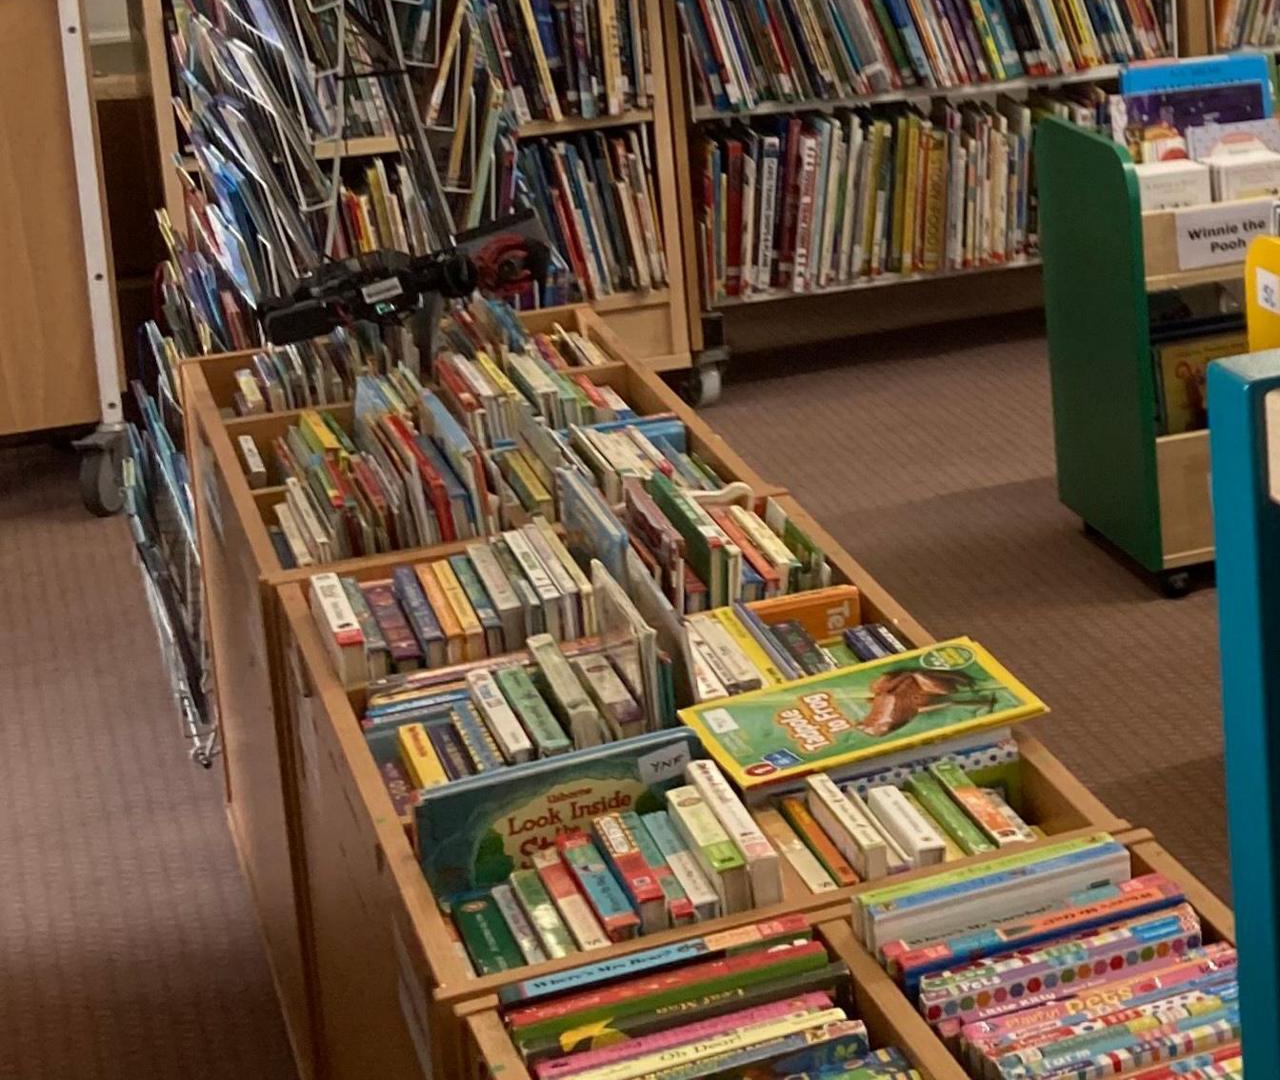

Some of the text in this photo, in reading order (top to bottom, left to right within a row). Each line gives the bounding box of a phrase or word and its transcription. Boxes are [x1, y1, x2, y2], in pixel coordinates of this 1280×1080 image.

[1188, 218, 1266, 242] Winnie the
[1210, 238, 1247, 254] Pooh
[777, 708, 830, 752] Tadpole
[802, 692, 851, 732] to Frog
[507, 789, 633, 837] Look Inside
